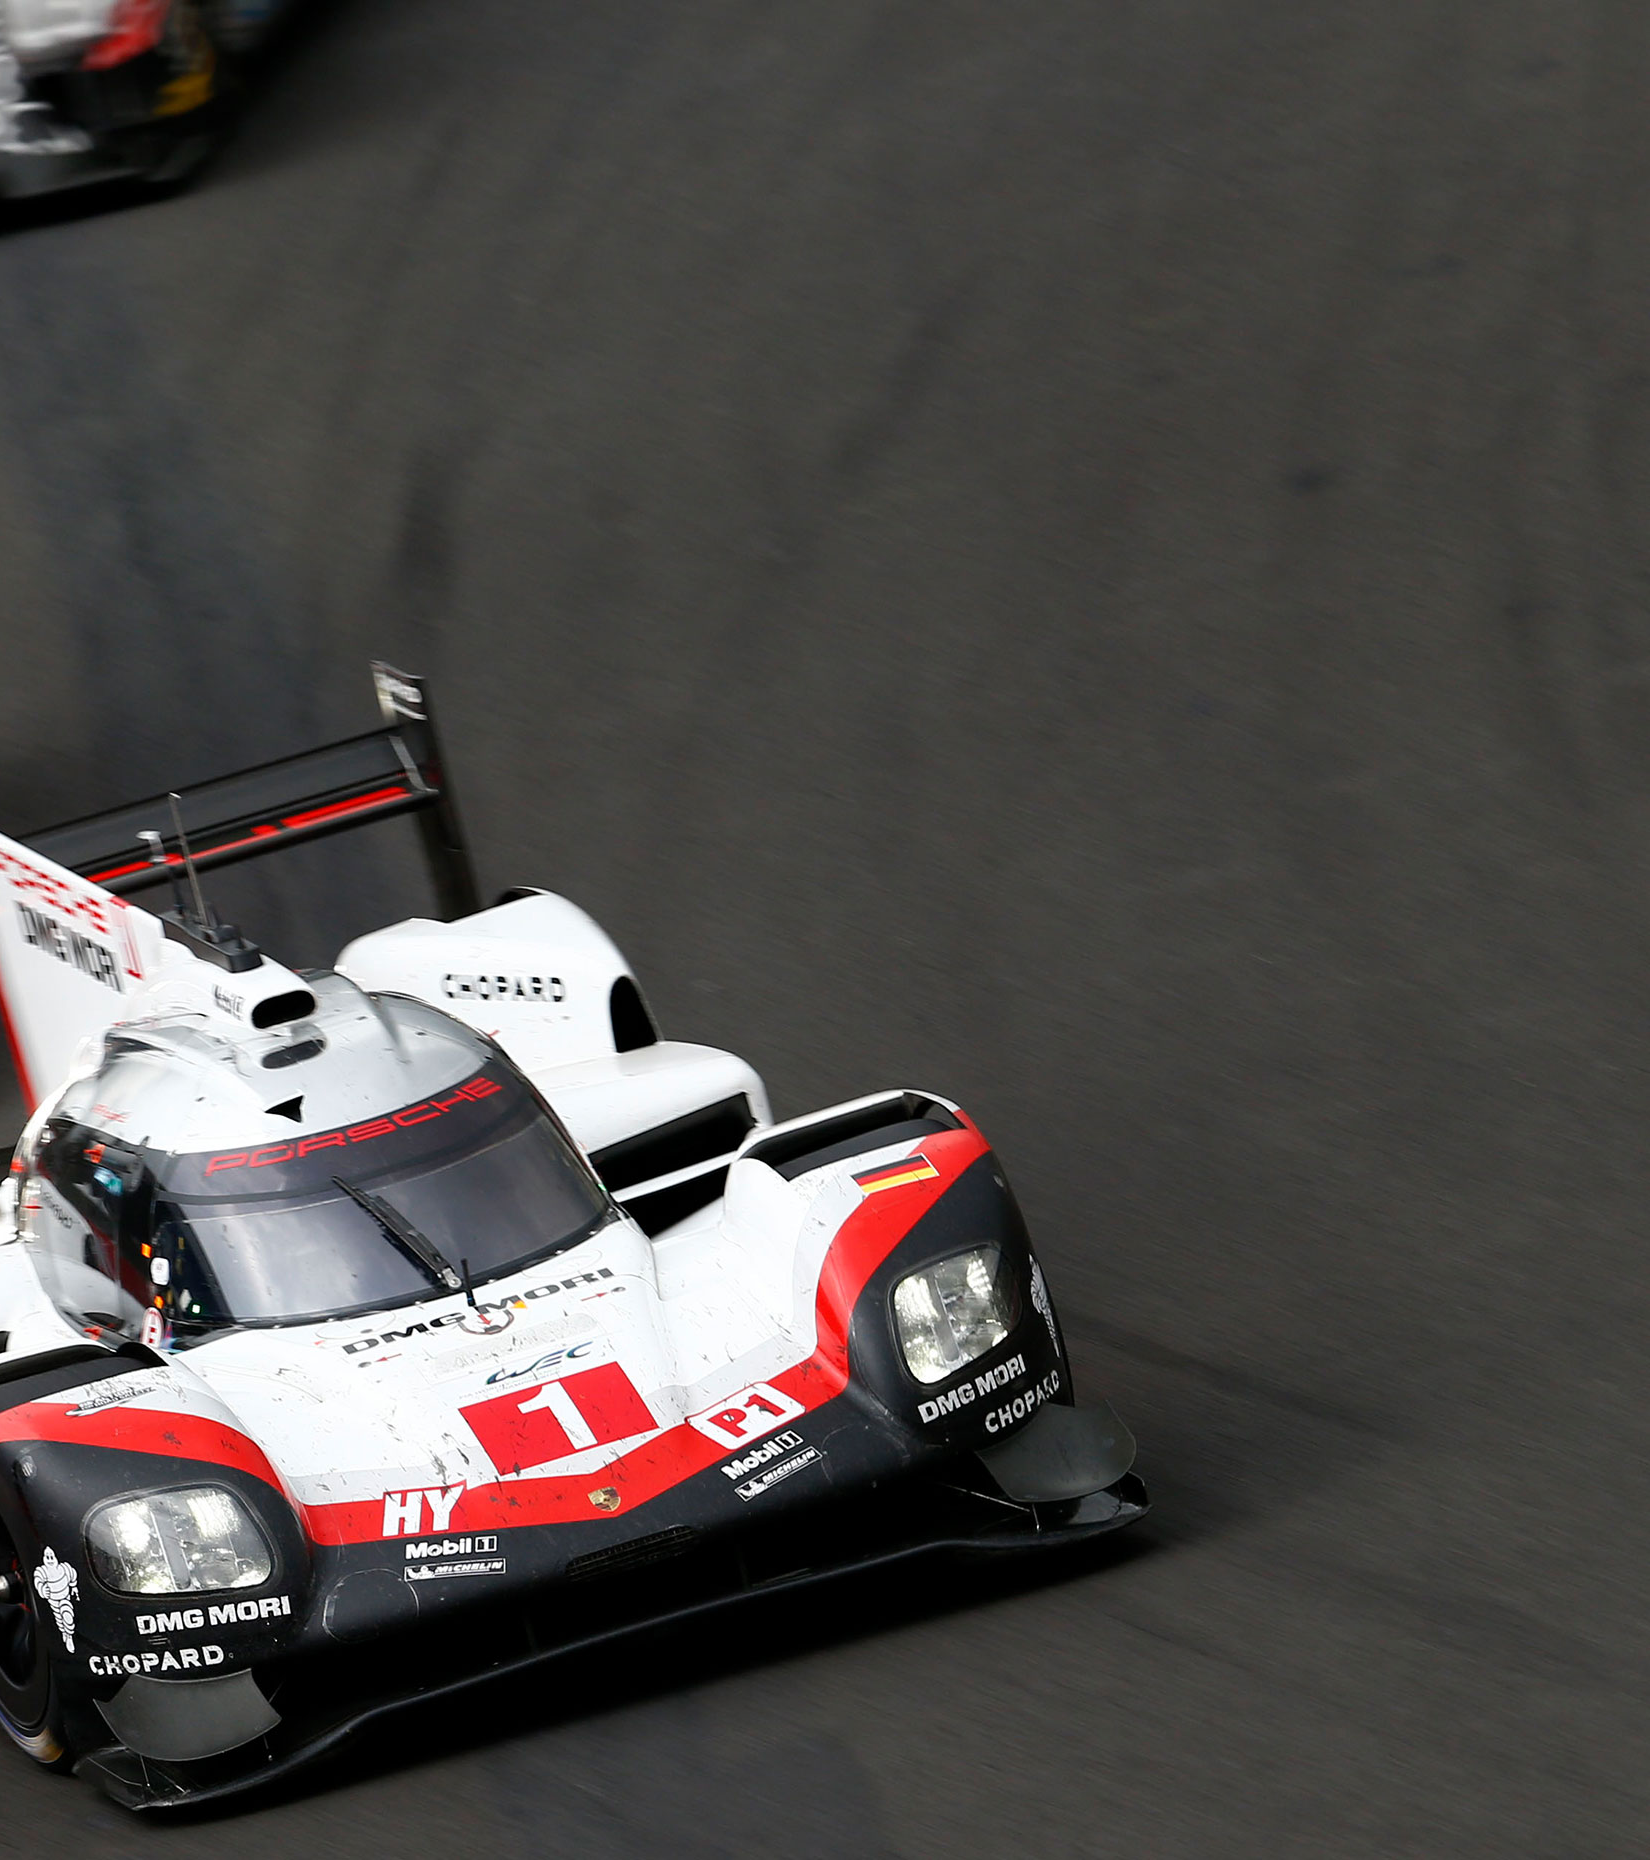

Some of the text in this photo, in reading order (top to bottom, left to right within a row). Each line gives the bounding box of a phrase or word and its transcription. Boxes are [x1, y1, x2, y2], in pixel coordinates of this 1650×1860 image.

[440, 973, 567, 1003] CHOPARD
[203, 1076, 503, 1177] PORSCHE
[341, 1267, 615, 1355] DMG MORI
[486, 1341, 593, 1385] WEC
[917, 1353, 1027, 1425] DMG MORI
[984, 1369, 1061, 1433] CHOPARD
[516, 1380, 599, 1451] 1
[707, 1393, 787, 1438] P1
[721, 1440, 784, 1480] Mobil
[762, 1449, 816, 1484] MICHELIN
[382, 1485, 465, 1537] HY
[405, 1537, 472, 1560] Mobil
[434, 1560, 504, 1574] MICHELIN
[136, 1595, 292, 1635] DMG MORI
[88, 1644, 225, 1676] CHOPARD
